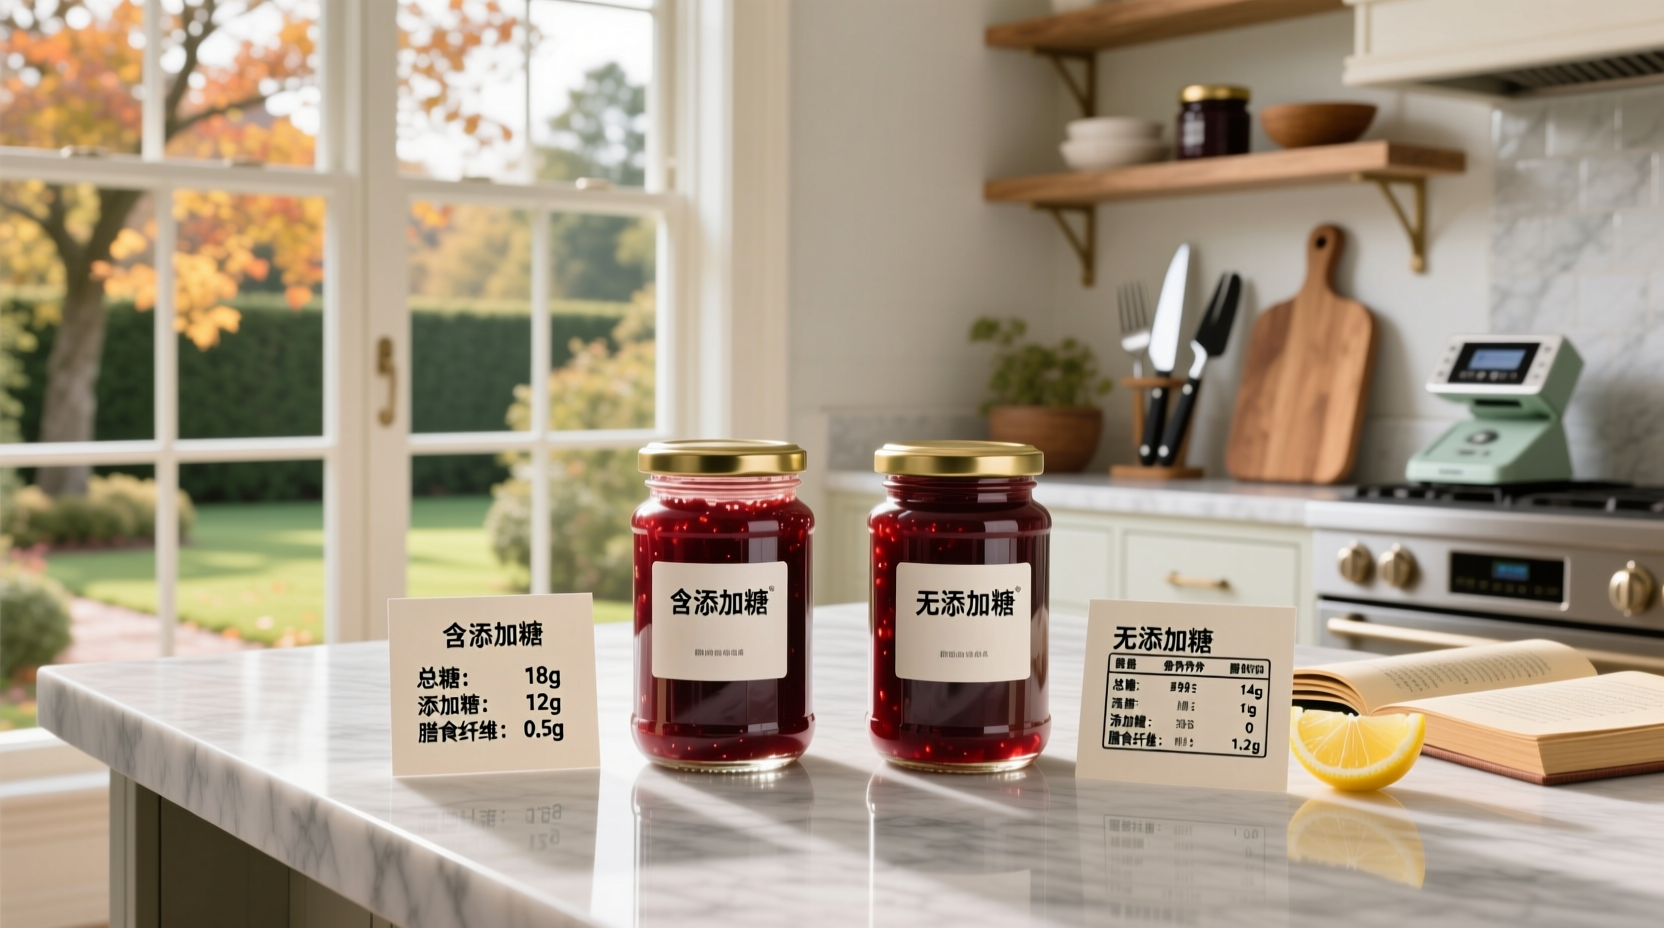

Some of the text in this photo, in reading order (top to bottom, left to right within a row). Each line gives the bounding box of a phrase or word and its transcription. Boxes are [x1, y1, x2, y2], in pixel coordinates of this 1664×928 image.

[670, 587, 769, 617] 含添加糖
[915, 588, 1016, 617] 无添加糖
[442, 620, 544, 649] 含添加糖
[1112, 625, 1214, 655] 无添加糖
[416, 665, 561, 690] 总糖： 18g
[1240, 683, 1263, 700] 14g
[417, 693, 561, 717] 添加糖： 12g
[523, 719, 565, 742] 0.5g
[1245, 721, 1254, 734] 0
[1231, 738, 1261, 755] 1.2g
